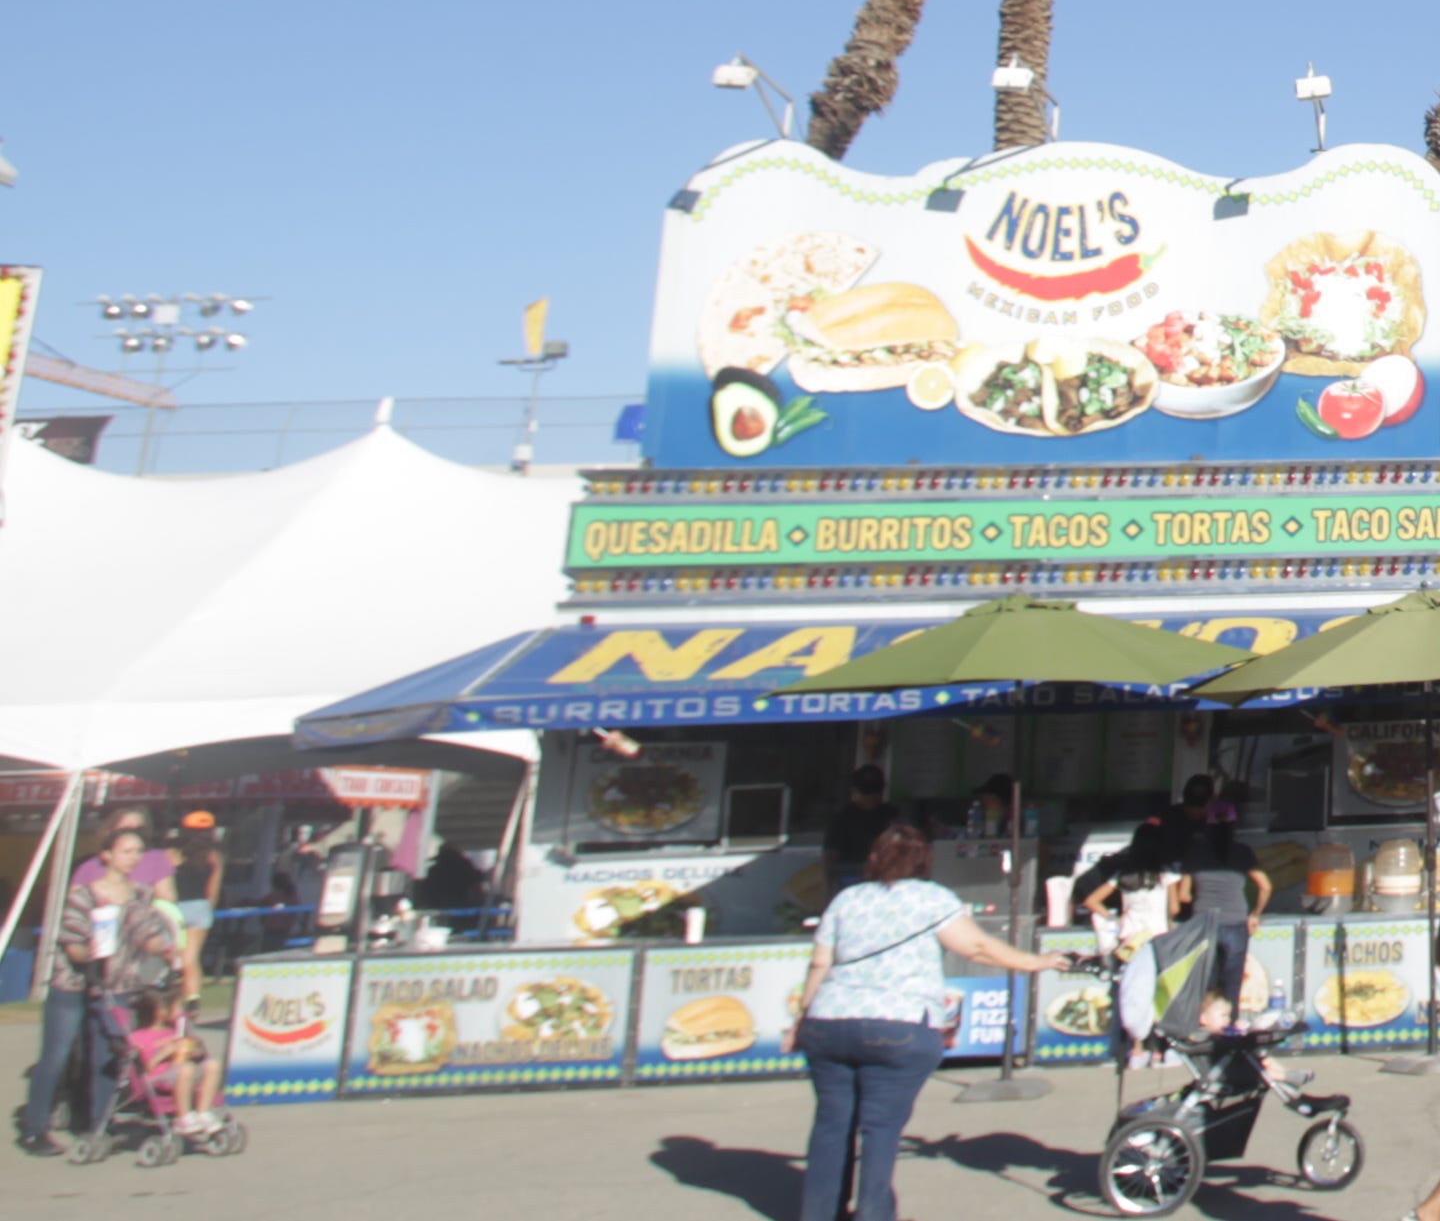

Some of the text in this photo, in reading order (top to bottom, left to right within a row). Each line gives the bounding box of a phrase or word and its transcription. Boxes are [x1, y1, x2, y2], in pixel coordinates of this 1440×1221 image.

[985, 190, 1141, 262] NOEL'S
[967, 282, 1160, 324] MEXICAN FOOD
[583, 518, 780, 558] QUESADILLA
[814, 516, 973, 551] BURRITOS
[1009, 514, 1109, 548] TACOS
[1153, 511, 1271, 545] TORTAS
[1313, 509, 1394, 542] TACO
[494, 696, 741, 722] BURRITOS
[778, 690, 922, 716] TORTAS
[367, 977, 499, 1006] TACO SALAD
[670, 966, 753, 994] TORTAS
